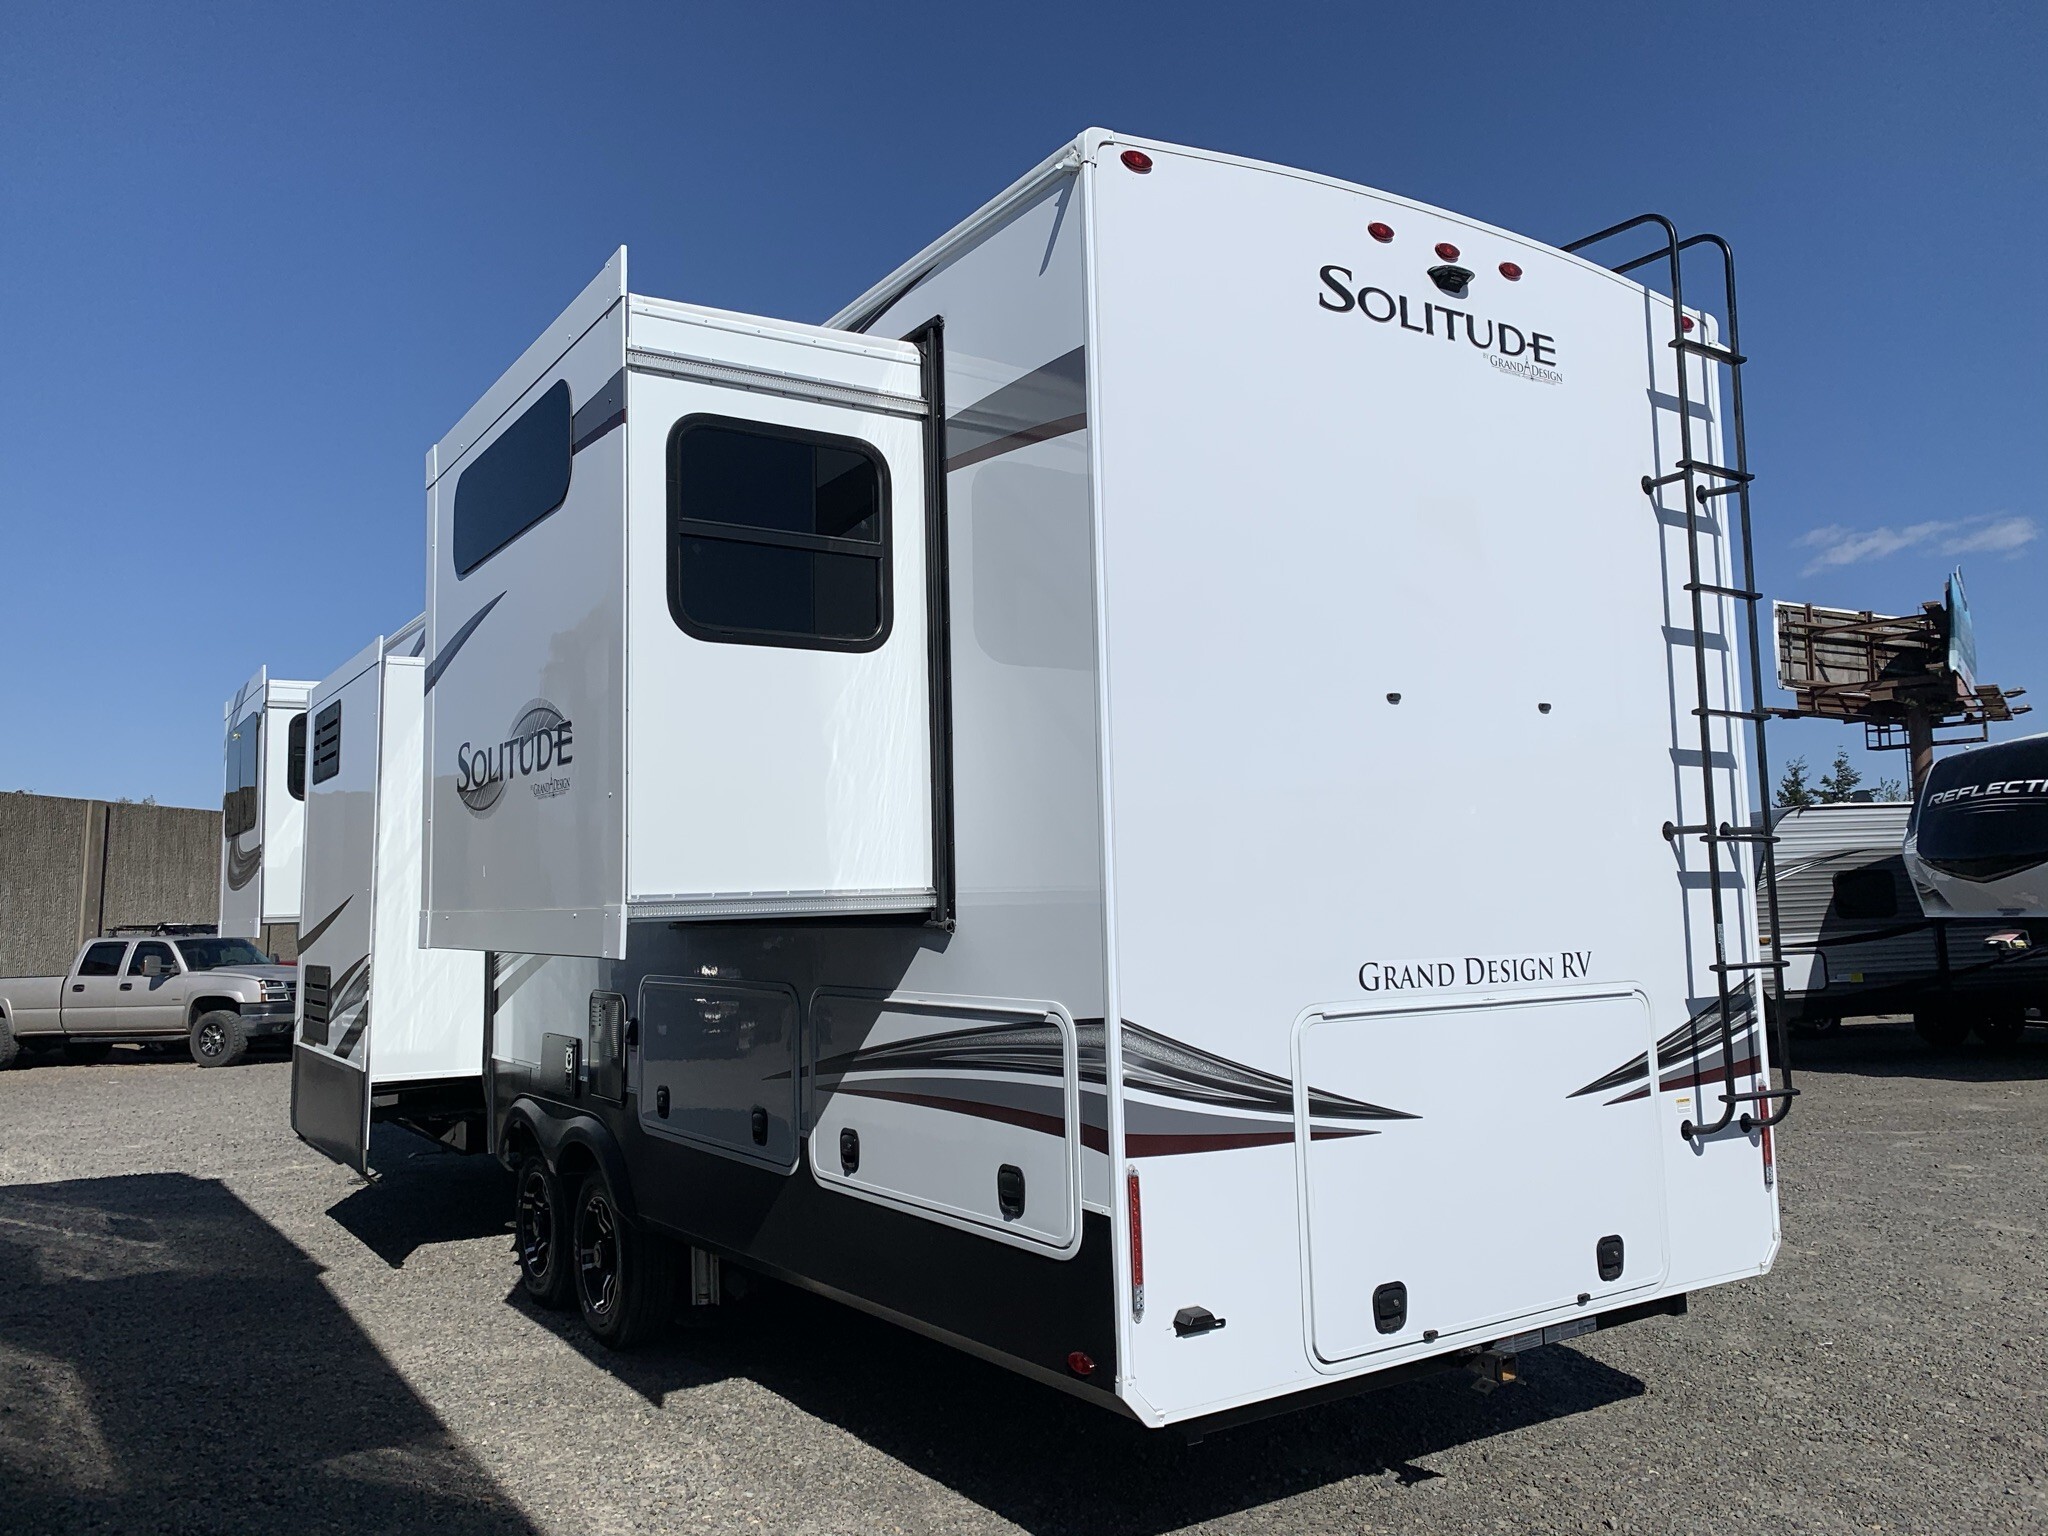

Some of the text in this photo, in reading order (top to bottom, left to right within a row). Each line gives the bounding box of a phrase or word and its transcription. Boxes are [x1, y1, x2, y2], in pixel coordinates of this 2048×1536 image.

[1319, 265, 1557, 367] SOLITUDE
[1490, 355, 1524, 373] GRAND
[1532, 364, 1564, 382] DESIGN
[457, 720, 573, 793] SOLITUDE
[1359, 951, 1593, 991] GRAND DESIGN RV
